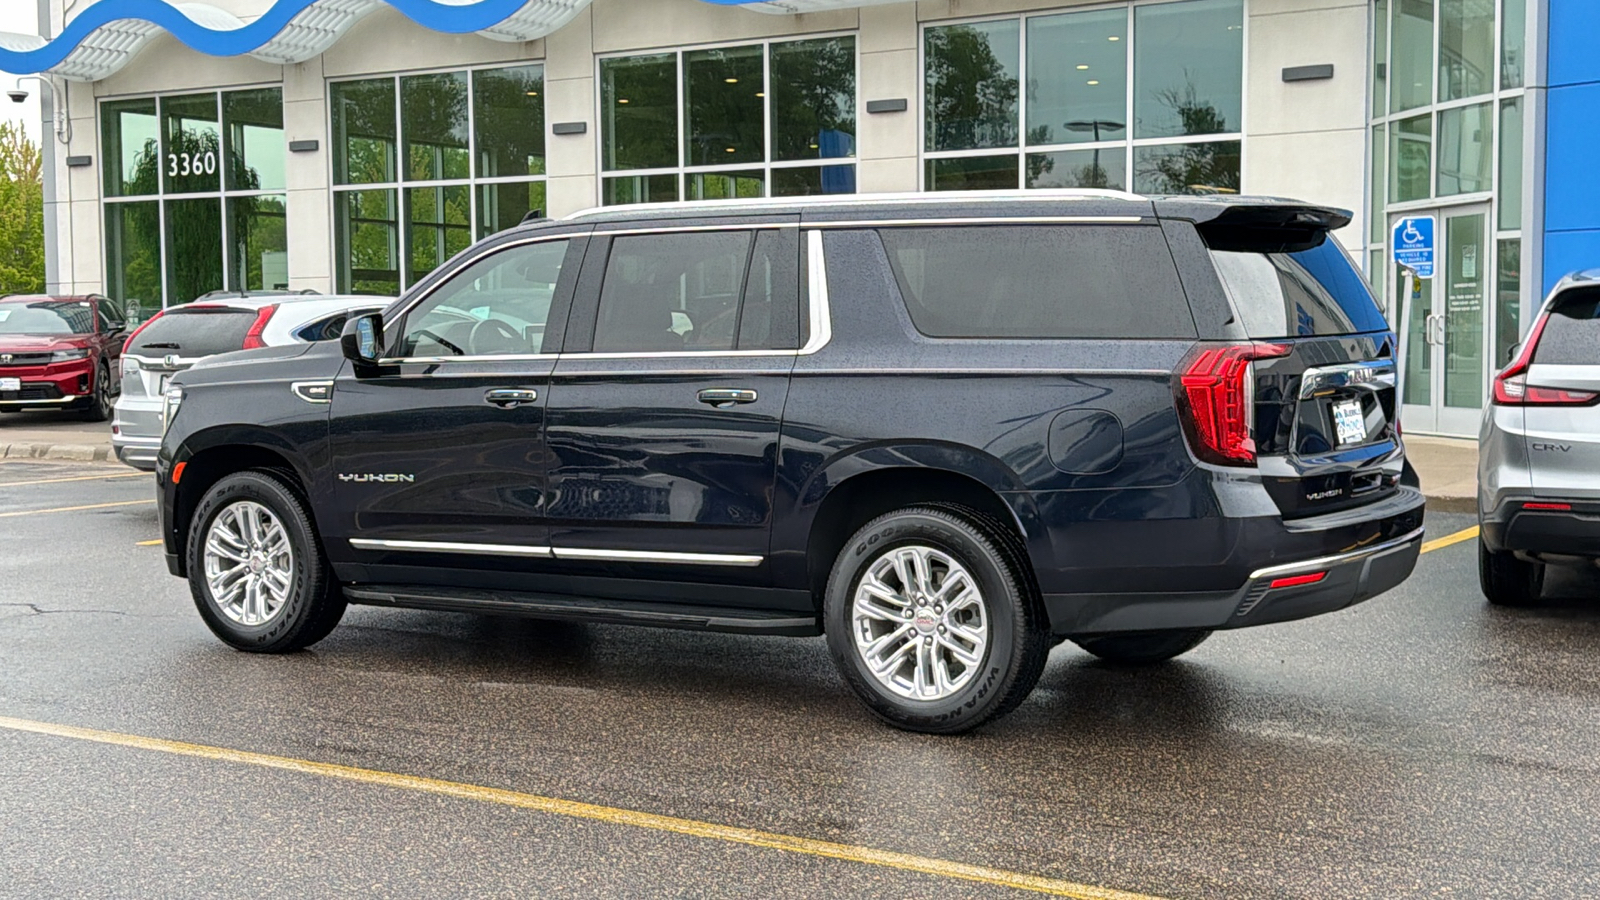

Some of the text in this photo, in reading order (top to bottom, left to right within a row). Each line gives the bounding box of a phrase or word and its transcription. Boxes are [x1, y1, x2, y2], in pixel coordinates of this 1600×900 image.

[168, 151, 216, 177] 3360
[1532, 443, 1571, 452] CR-V
[338, 473, 414, 482] YUKON
[1306, 488, 1342, 500] YUKON
